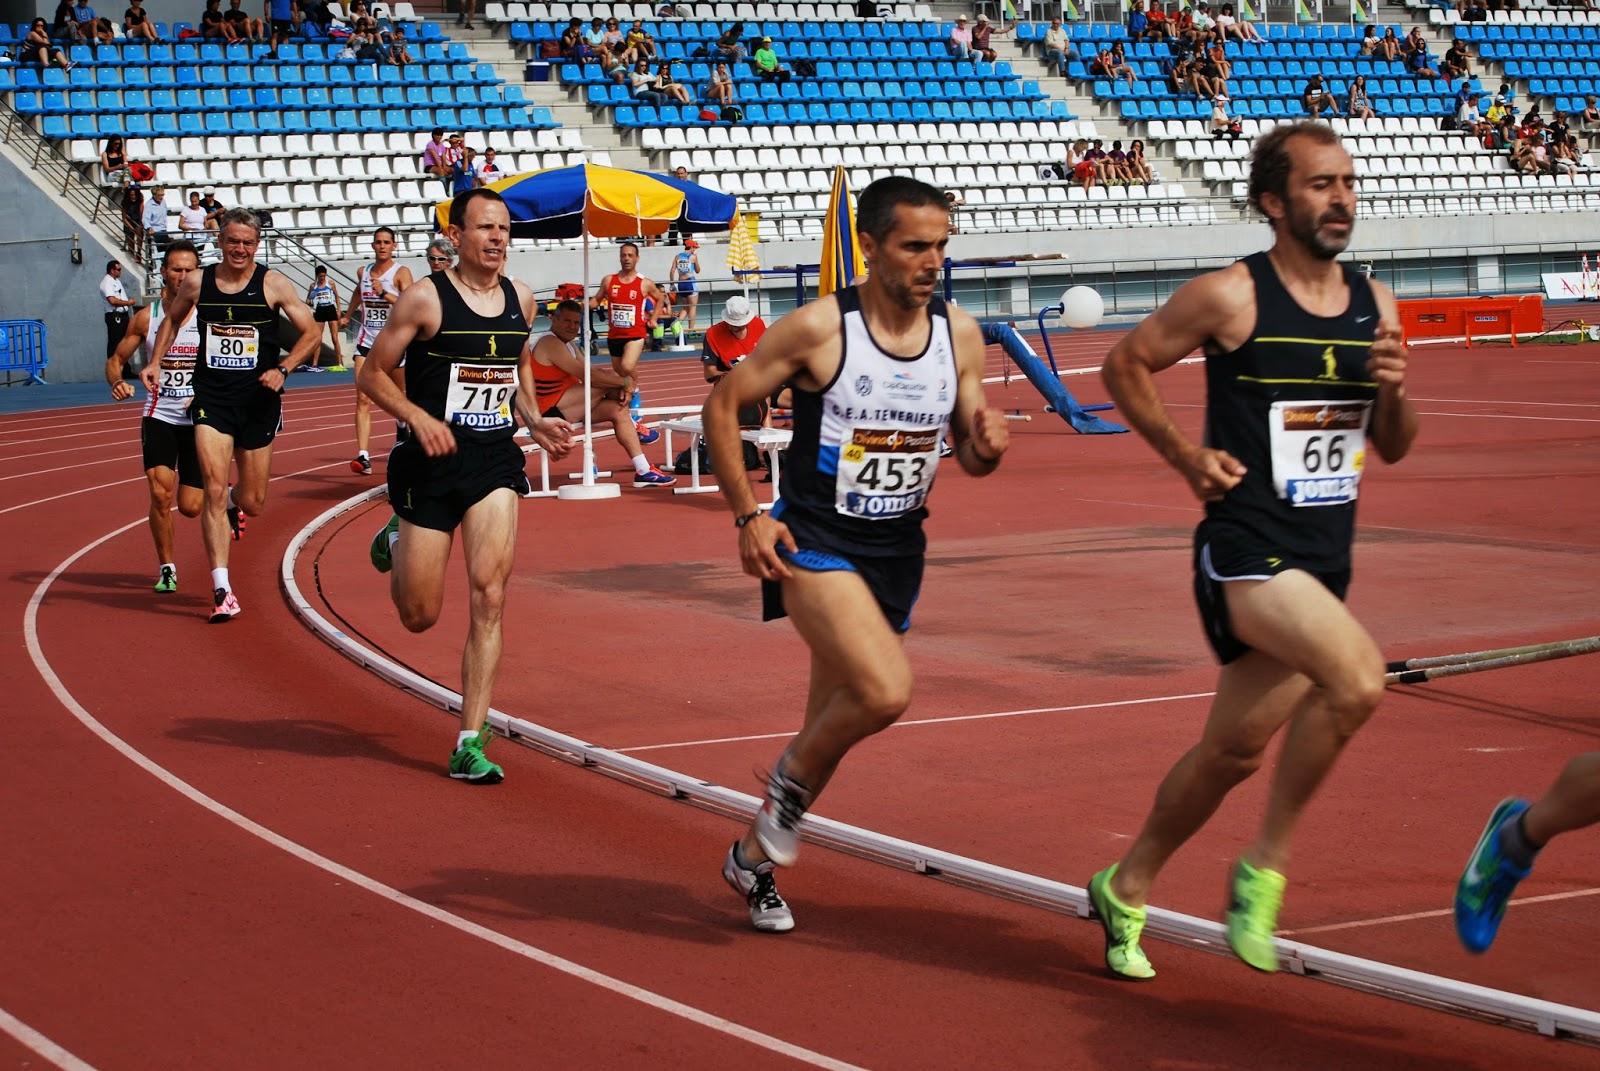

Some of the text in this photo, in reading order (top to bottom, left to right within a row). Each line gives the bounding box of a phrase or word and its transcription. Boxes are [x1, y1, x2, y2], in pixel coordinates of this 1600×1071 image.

[367, 310, 387, 320] 438
[613, 311, 630, 320] 661
[220, 338, 244, 356] 80
[164, 371, 194, 387] 292
[460, 369, 482, 378] Divina
[462, 386, 508, 411] 719
[854, 432, 887, 445] Divina
[847, 449, 861, 460] 40
[1303, 435, 1346, 473] 66
[856, 457, 926, 491] 453
